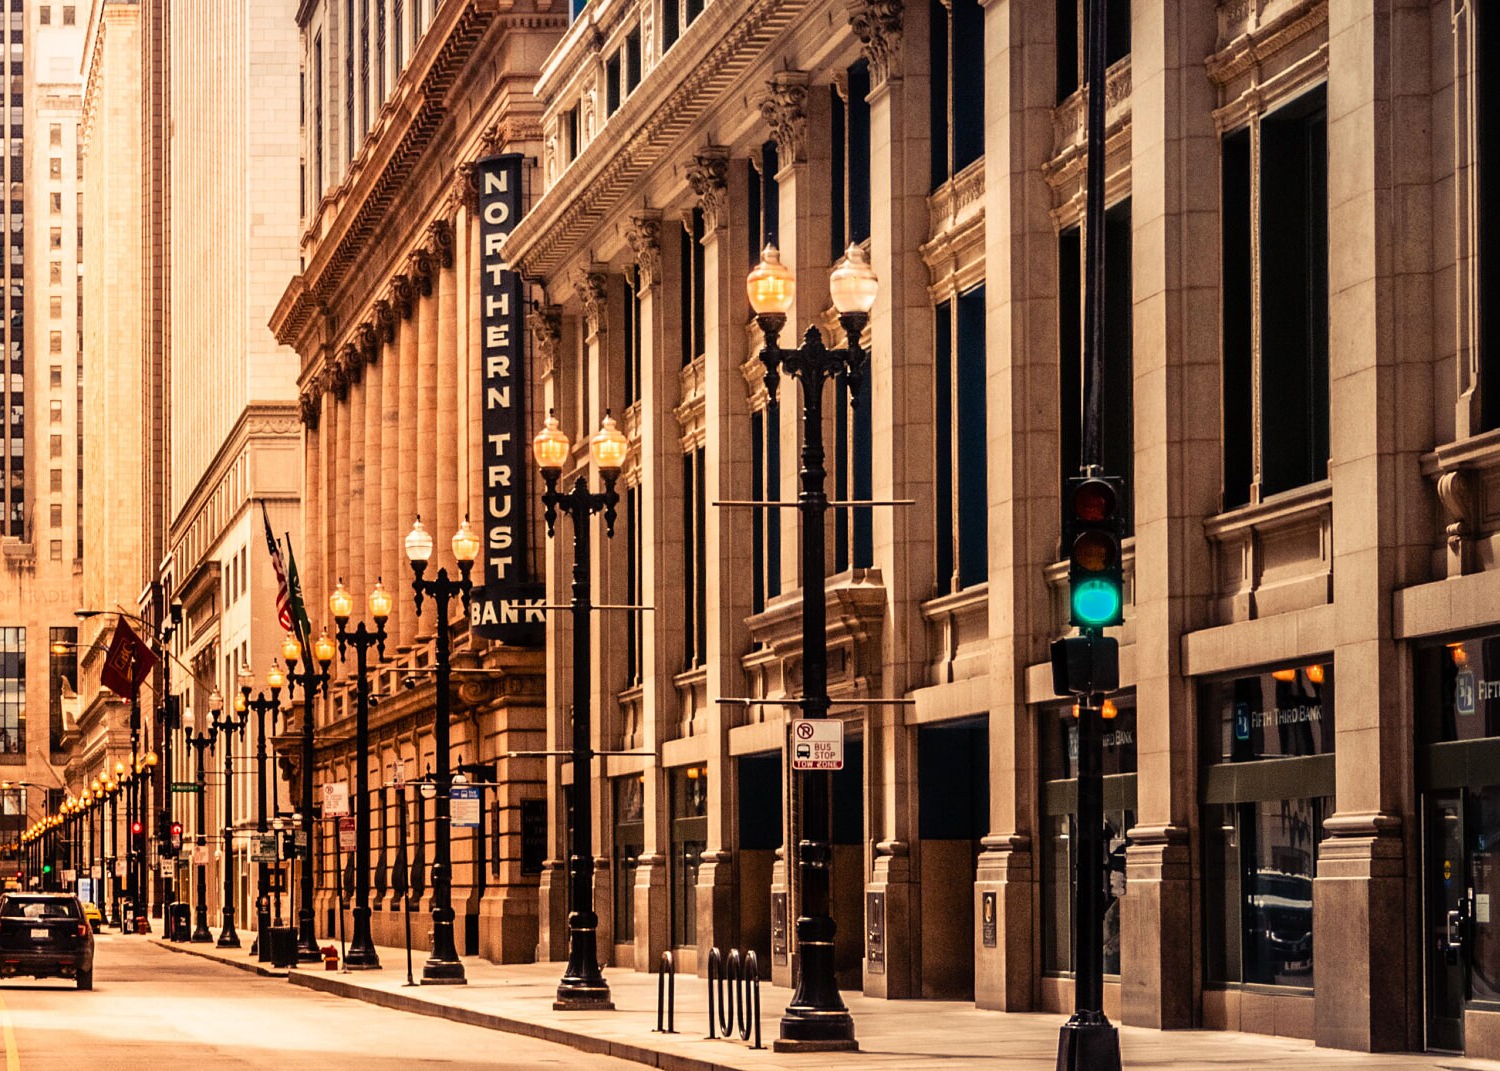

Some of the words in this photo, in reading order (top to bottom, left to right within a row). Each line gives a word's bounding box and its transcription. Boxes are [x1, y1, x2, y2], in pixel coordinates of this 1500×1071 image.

[484, 170, 511, 409] NORTHERN
[488, 432, 512, 580] TRUST
[21, 589, 69, 603] TRADE
[471, 599, 547, 626] BANK
[1478, 680, 1500, 700] FIFT
[1274, 708, 1299, 725] THIRD
[814, 743, 831, 751] BUS
